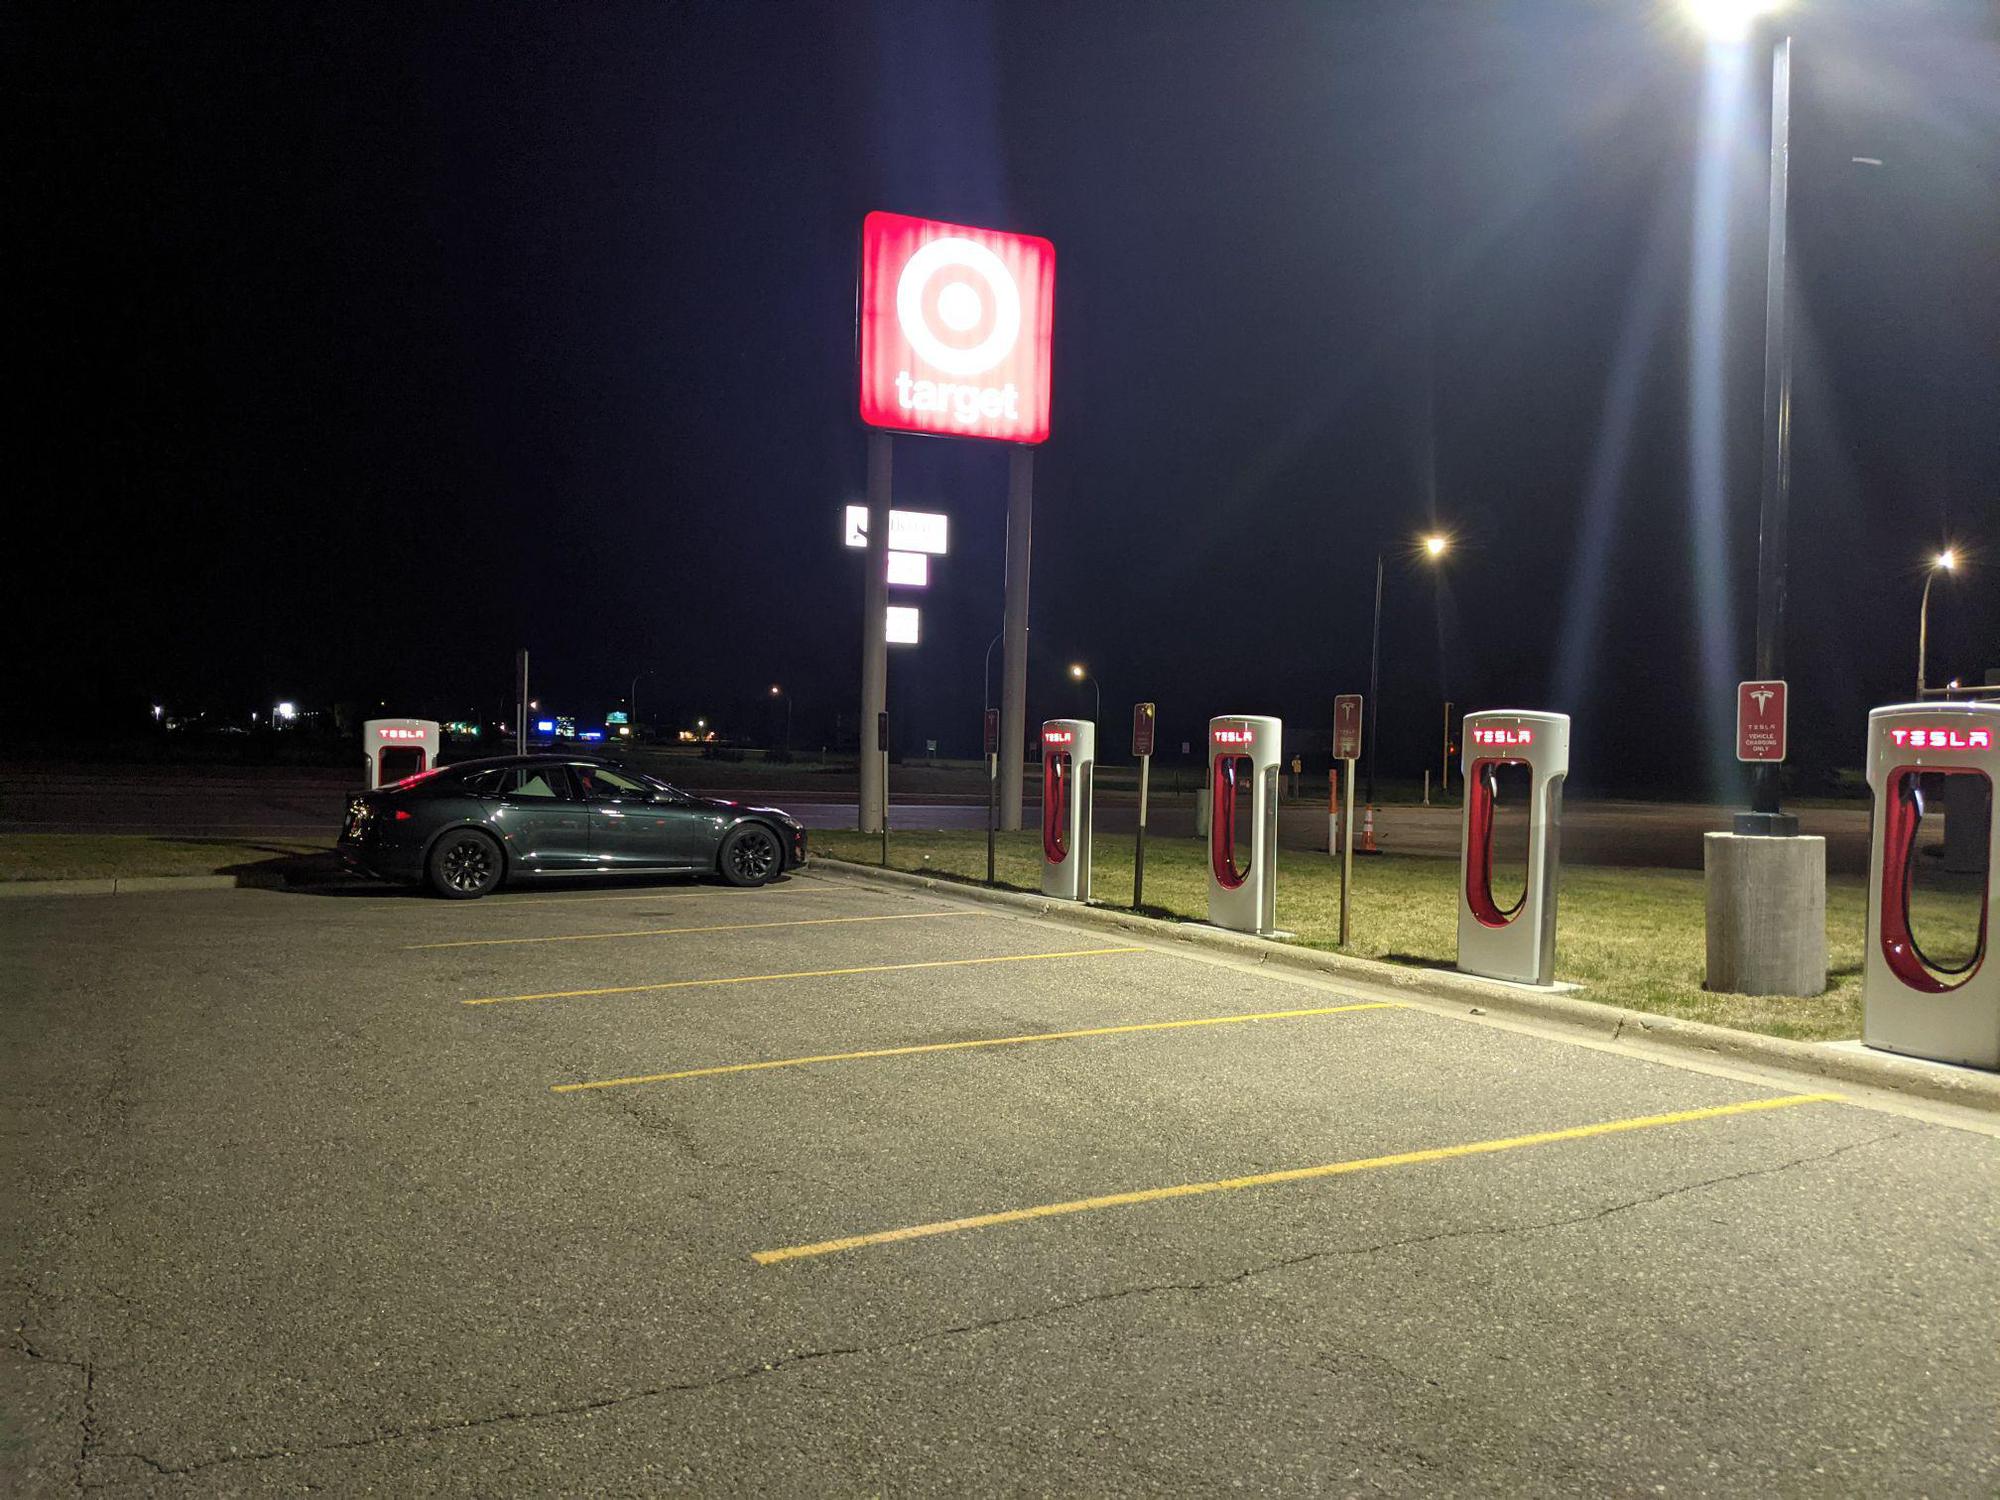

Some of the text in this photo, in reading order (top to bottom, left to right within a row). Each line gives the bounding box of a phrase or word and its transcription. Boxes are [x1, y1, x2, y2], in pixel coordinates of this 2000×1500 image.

[895, 370, 1018, 423] target
[380, 729, 424, 739] TESLA
[1045, 732, 1071, 743] TESLA
[1215, 731, 1253, 743] TESLA
[1474, 730, 1531, 743] TESLA
[1891, 730, 1988, 747] TESLA
